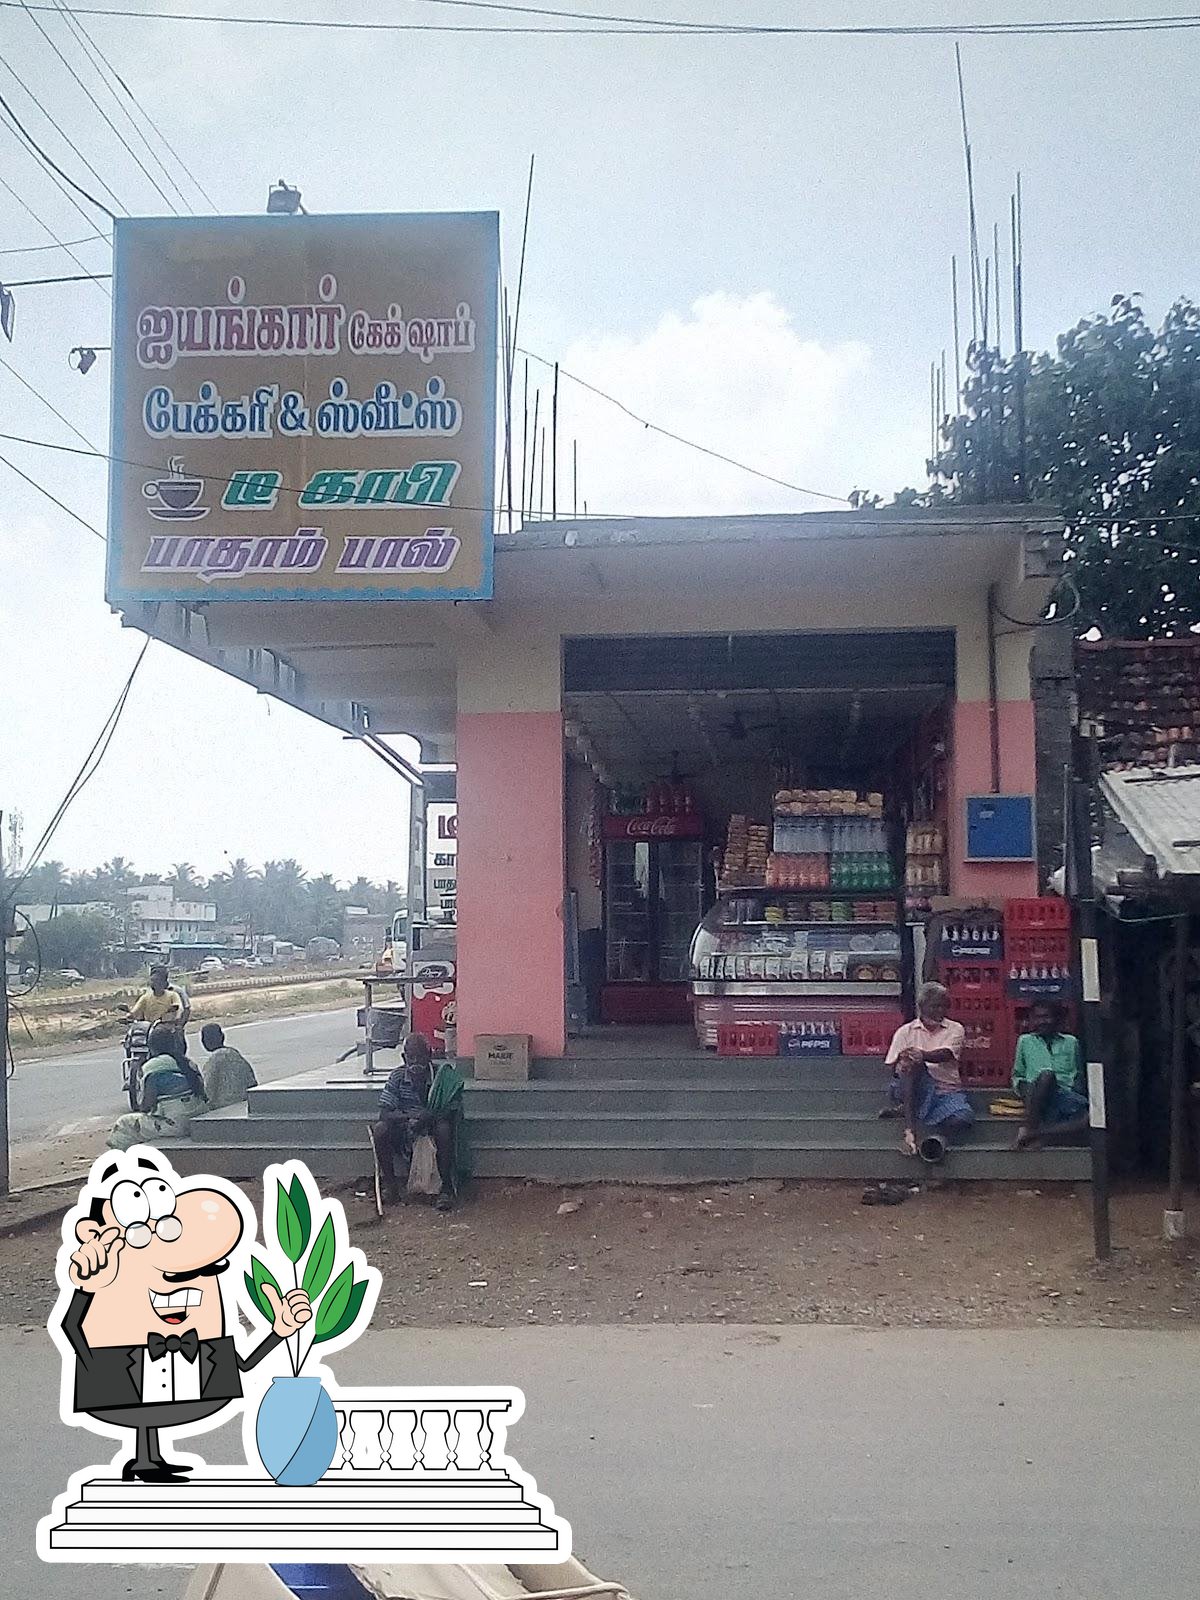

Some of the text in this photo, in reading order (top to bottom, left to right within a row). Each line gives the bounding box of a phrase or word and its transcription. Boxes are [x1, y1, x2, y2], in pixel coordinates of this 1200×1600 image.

[138, 276, 474, 367] ஐயங்கார் கேக் ஷாப்
[144, 377, 459, 436] பேக்கரி & ஸ்வீட்ஸ்
[299, 461, 460, 507] காபி
[142, 528, 458, 580] பாதாம் பால்
